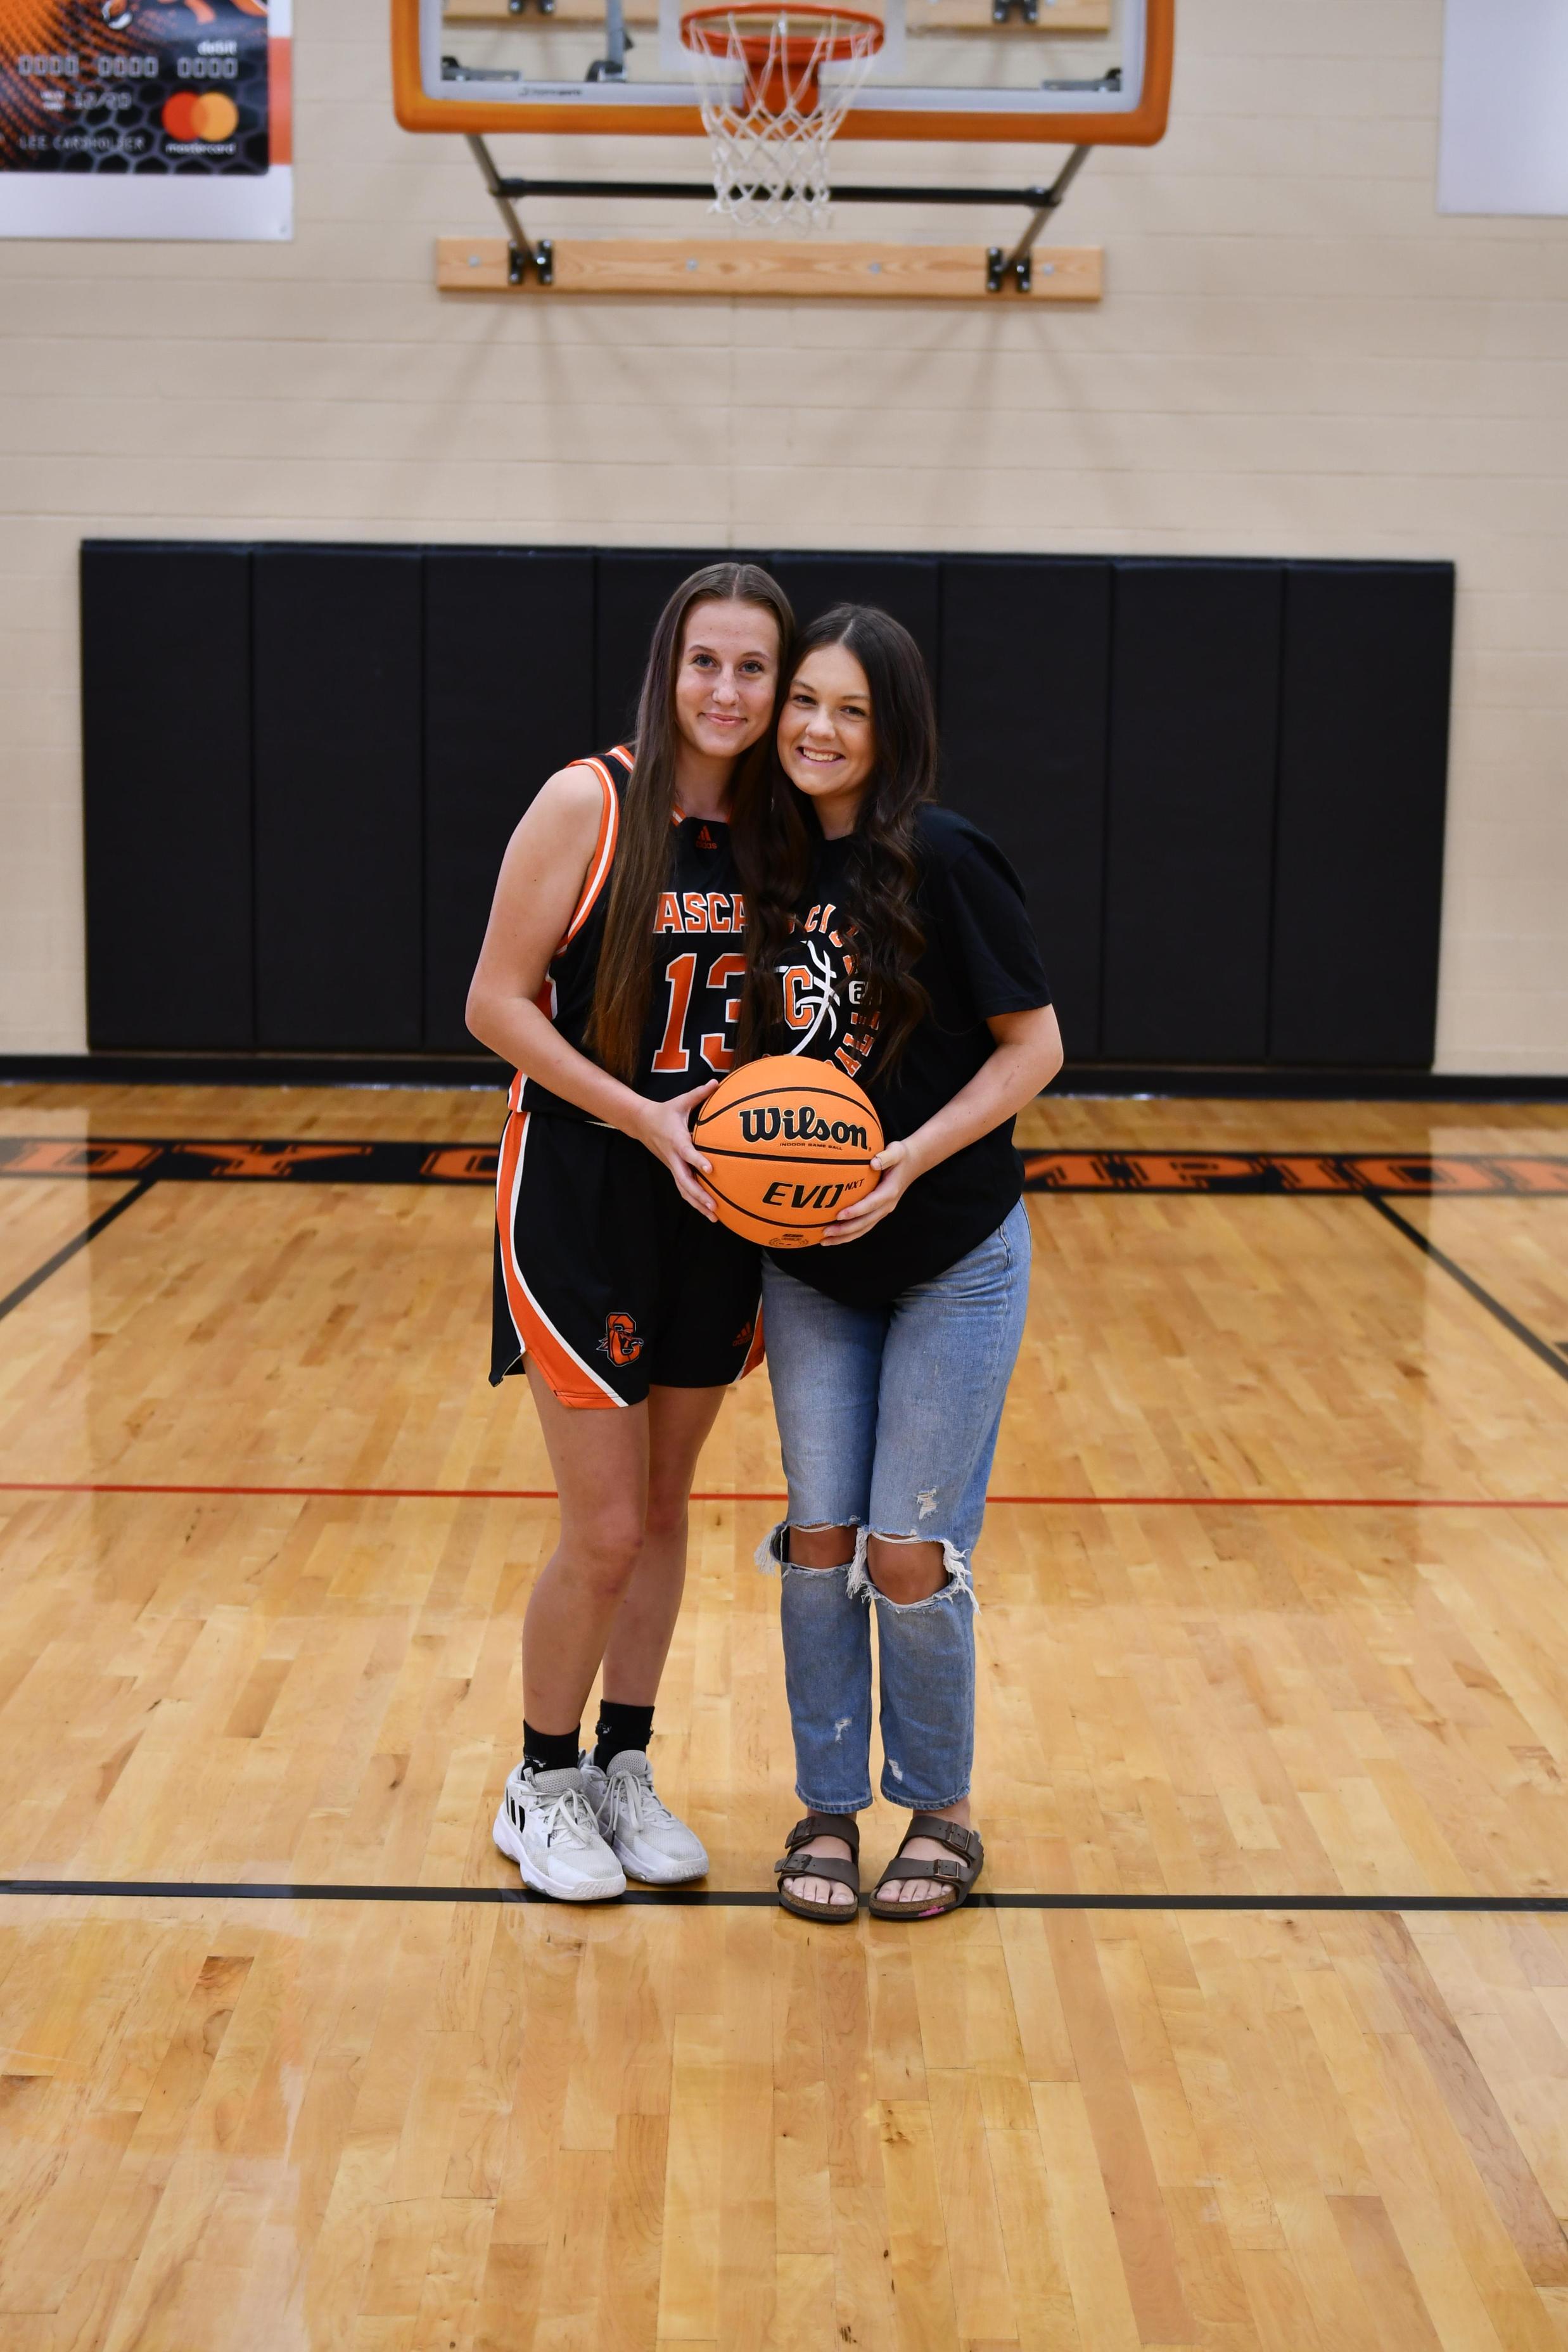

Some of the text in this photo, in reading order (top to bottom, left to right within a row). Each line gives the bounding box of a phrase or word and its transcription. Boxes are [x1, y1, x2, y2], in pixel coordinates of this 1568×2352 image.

[197, 40, 238, 56] debit
[18, 55, 238, 79] 0000 0000 0000
[19, 134, 48, 151] LEE
[165, 142, 236, 155] mastercard
[651, 953, 747, 1073] 13
[738, 1105, 868, 1151] Wilson
[762, 1178, 865, 1209] EVO NXT
